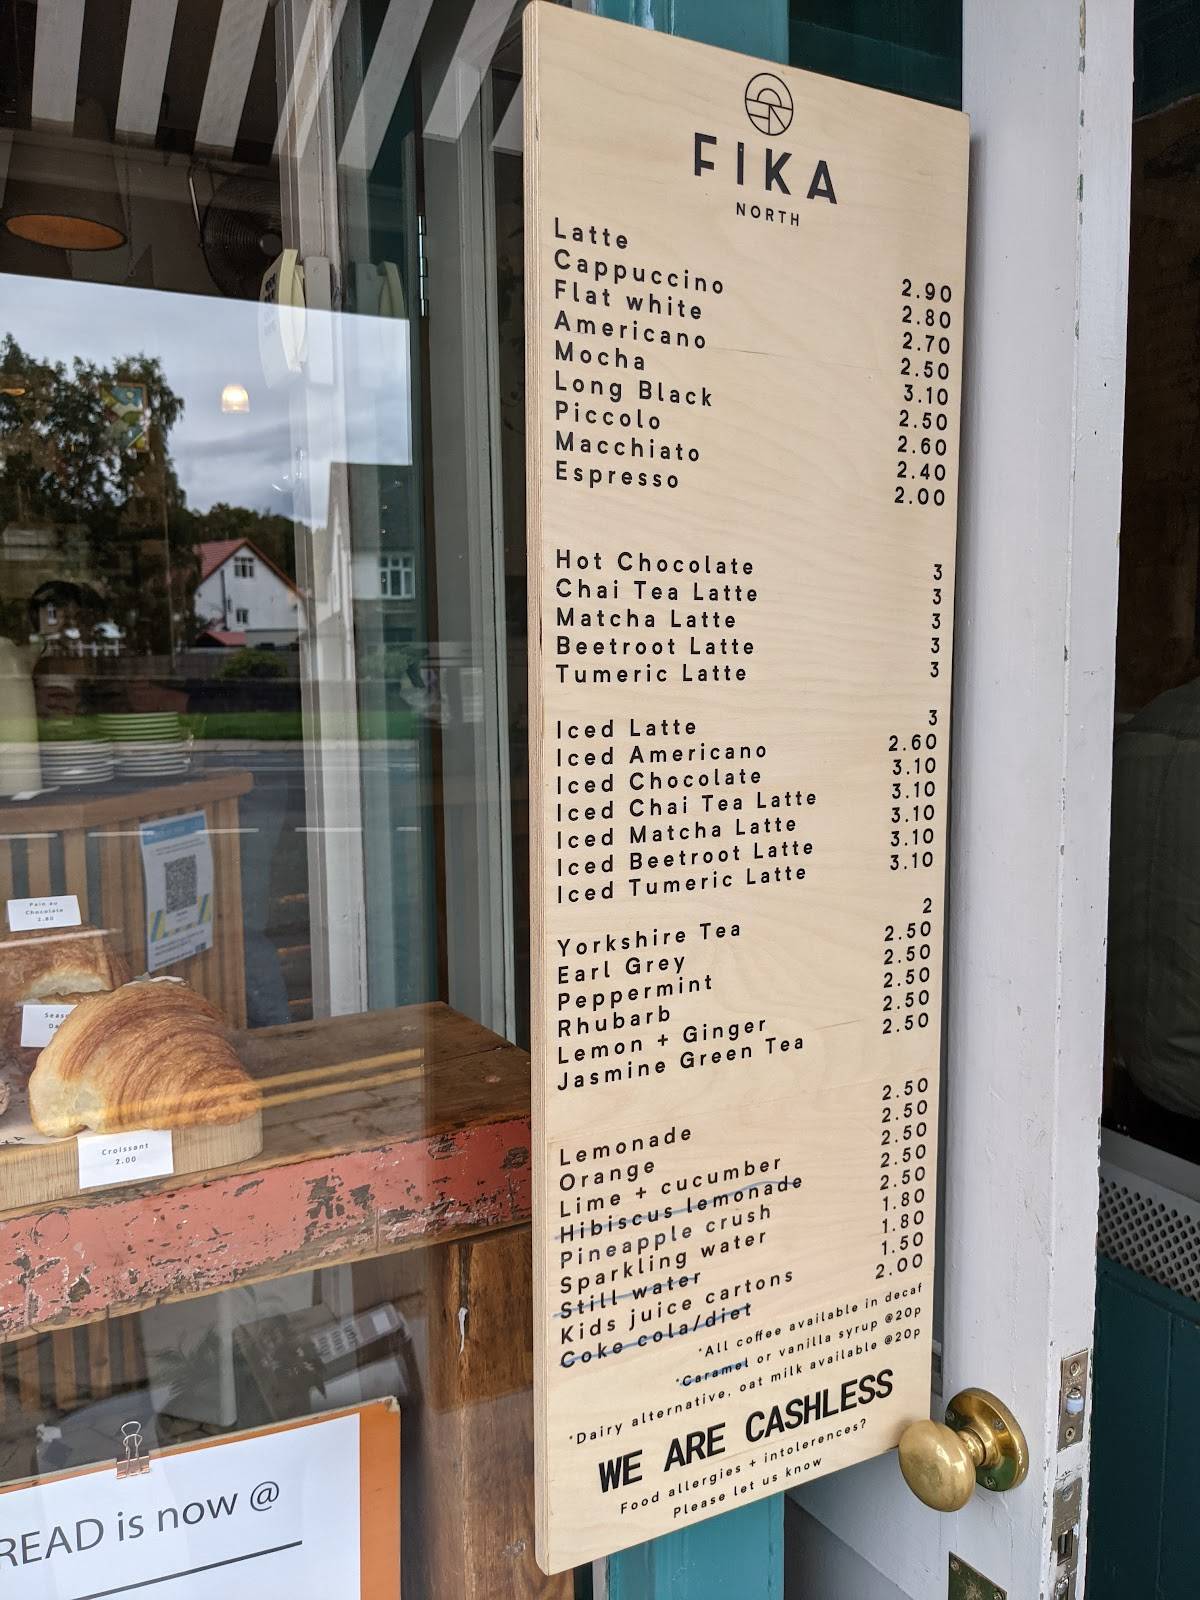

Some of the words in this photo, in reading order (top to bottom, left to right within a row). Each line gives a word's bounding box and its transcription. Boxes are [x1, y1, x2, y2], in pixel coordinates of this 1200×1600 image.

[694, 132, 838, 205] FIKA
[736, 201, 799, 227] NORTH
[554, 217, 628, 250] Latte
[901, 278, 952, 304] 2.90
[554, 248, 724, 295] Cappuccino
[901, 305, 951, 330] 2.80
[553, 310, 706, 349] Americano
[900, 357, 949, 380] 2.50
[555, 278, 610, 307] Flat
[625, 293, 702, 320] white
[902, 331, 950, 355] 2.70
[555, 339, 645, 371] Mocha
[903, 383, 949, 406] 3.10
[555, 370, 622, 403] Long
[639, 379, 712, 407] Black
[899, 409, 948, 431] 2.50
[555, 400, 660, 430] Piccolo
[897, 434, 947, 457] 2.60
[555, 430, 700, 462] Macchiato
[896, 460, 946, 482] 2.40
[556, 460, 679, 489] Espresso
[894, 485, 945, 507] 2.00
[555, 577, 618, 599] Chai
[633, 580, 678, 601] Tea
[693, 582, 757, 602] Latte
[932, 588, 942, 606] 3
[556, 548, 602, 570] Hot
[617, 551, 753, 575] Chocolate
[933, 563, 943, 581] 3
[556, 606, 655, 628] Matcha
[670, 609, 736, 629] Latte
[931, 612, 941, 630] 3
[556, 635, 675, 656] Beetroot
[690, 636, 754, 655] Latte
[930, 637, 940, 654] 3
[555, 663, 667, 684] Tumeric
[682, 663, 746, 682] Latte
[930, 661, 939, 678] 3
[557, 719, 614, 740] Iced
[630, 718, 696, 737] Latte
[928, 709, 938, 726] 3
[557, 746, 614, 767] Iced
[628, 742, 766, 764] Americano
[888, 733, 937, 752] 2.60
[557, 773, 614, 795] Iced
[629, 768, 761, 791] Chocolate
[892, 757, 936, 776] 3.10
[557, 800, 614, 822] Iced
[629, 795, 687, 818] Chai
[701, 794, 742, 813] Tea
[757, 790, 816, 809] Latte
[891, 780, 936, 800] 3.10
[557, 827, 614, 850] Iced
[630, 821, 721, 844] Matcha
[735, 817, 796, 836] Latte
[891, 804, 935, 824] 3.10
[557, 854, 614, 877] Iced
[630, 845, 740, 871] Beetroot
[754, 840, 813, 860] Latte
[890, 827, 934, 847] 3.10
[557, 880, 614, 904] Iced
[628, 870, 733, 897] Tumeric
[746, 865, 806, 885] Latte
[890, 851, 934, 871] 3.10
[557, 928, 686, 957] Yorkshire
[699, 922, 740, 940] Tea
[922, 897, 932, 914] 2
[558, 960, 611, 985] Earl
[625, 956, 685, 975] Grey
[884, 920, 932, 942] 2.50
[558, 974, 712, 1012] Peppermint
[883, 943, 931, 966] 2.50
[558, 1004, 670, 1038] Rhubarb
[883, 966, 930, 989] 2.50
[557, 1060, 666, 1091] Jasmine
[679, 1046, 752, 1069] Green
[764, 1037, 803, 1055] Tea
[882, 1012, 929, 1035] 2.50
[558, 1039, 642, 1065] Lemon
[657, 1033, 669, 1047] +
[682, 1019, 766, 1044] Ginger
[882, 989, 930, 1012] 2.50
[101, 1143, 148, 1156] Croissant
[559, 1161, 655, 1192] Orange
[881, 1099, 928, 1124] 2.50
[560, 1126, 691, 1167] Lemonade
[882, 1077, 929, 1101] 2.50
[115, 1156, 137, 1165] 2.00
[560, 1193, 621, 1218] Lime
[635, 1186, 647, 1199] +
[661, 1158, 781, 1195] cucumber
[880, 1121, 927, 1146] 2.50
[560, 1206, 673, 1244] Hibiscus
[686, 1175, 802, 1214] lemonade
[880, 1143, 926, 1169] 2.50
[560, 1225, 692, 1270] Pineapple
[705, 1203, 771, 1233] crush
[879, 1166, 926, 1191] 2.50
[560, 1251, 687, 1295] Sparkling
[700, 1231, 766, 1258] water
[882, 1188, 925, 1212] 1.80
[560, 1288, 618, 1320] Still
[632, 1272, 701, 1300] water
[882, 1210, 924, 1234] 1.80
[560, 1341, 624, 1369] Coke
[633, 1302, 751, 1347] cola/diet
[875, 1253, 923, 1280] 2.00
[561, 1317, 616, 1345] Kids
[628, 1298, 692, 1332] juice
[705, 1271, 793, 1304] cartons
[881, 1231, 924, 1256] 1.50
[736, 1327, 782, 1348] coffee
[789, 1304, 858, 1332] available
[865, 1298, 878, 1309] in
[885, 1282, 922, 1303] decaf
[739, 1376, 763, 1392] oat
[771, 1363, 802, 1383] milk
[810, 1341, 877, 1370] available
[756, 1353, 772, 1364] or
[779, 1334, 831, 1357] vanilla
[838, 1320, 878, 1339] syrup
[598, 1449, 643, 1494] WE
[663, 1421, 726, 1473] ARE
[745, 1368, 894, 1443] CASHLESS
[620, 1491, 659, 1515] Food
[668, 1465, 741, 1497] allergies
[764, 1418, 866, 1463] intolerences?
[673, 1493, 726, 1519] Please
[734, 1481, 754, 1497] let
[762, 1473, 779, 1487] us
[786, 1457, 822, 1478] know
[117, 1511, 144, 1541] is
[157, 1492, 239, 1532] now
[249, 1481, 280, 1512] @
